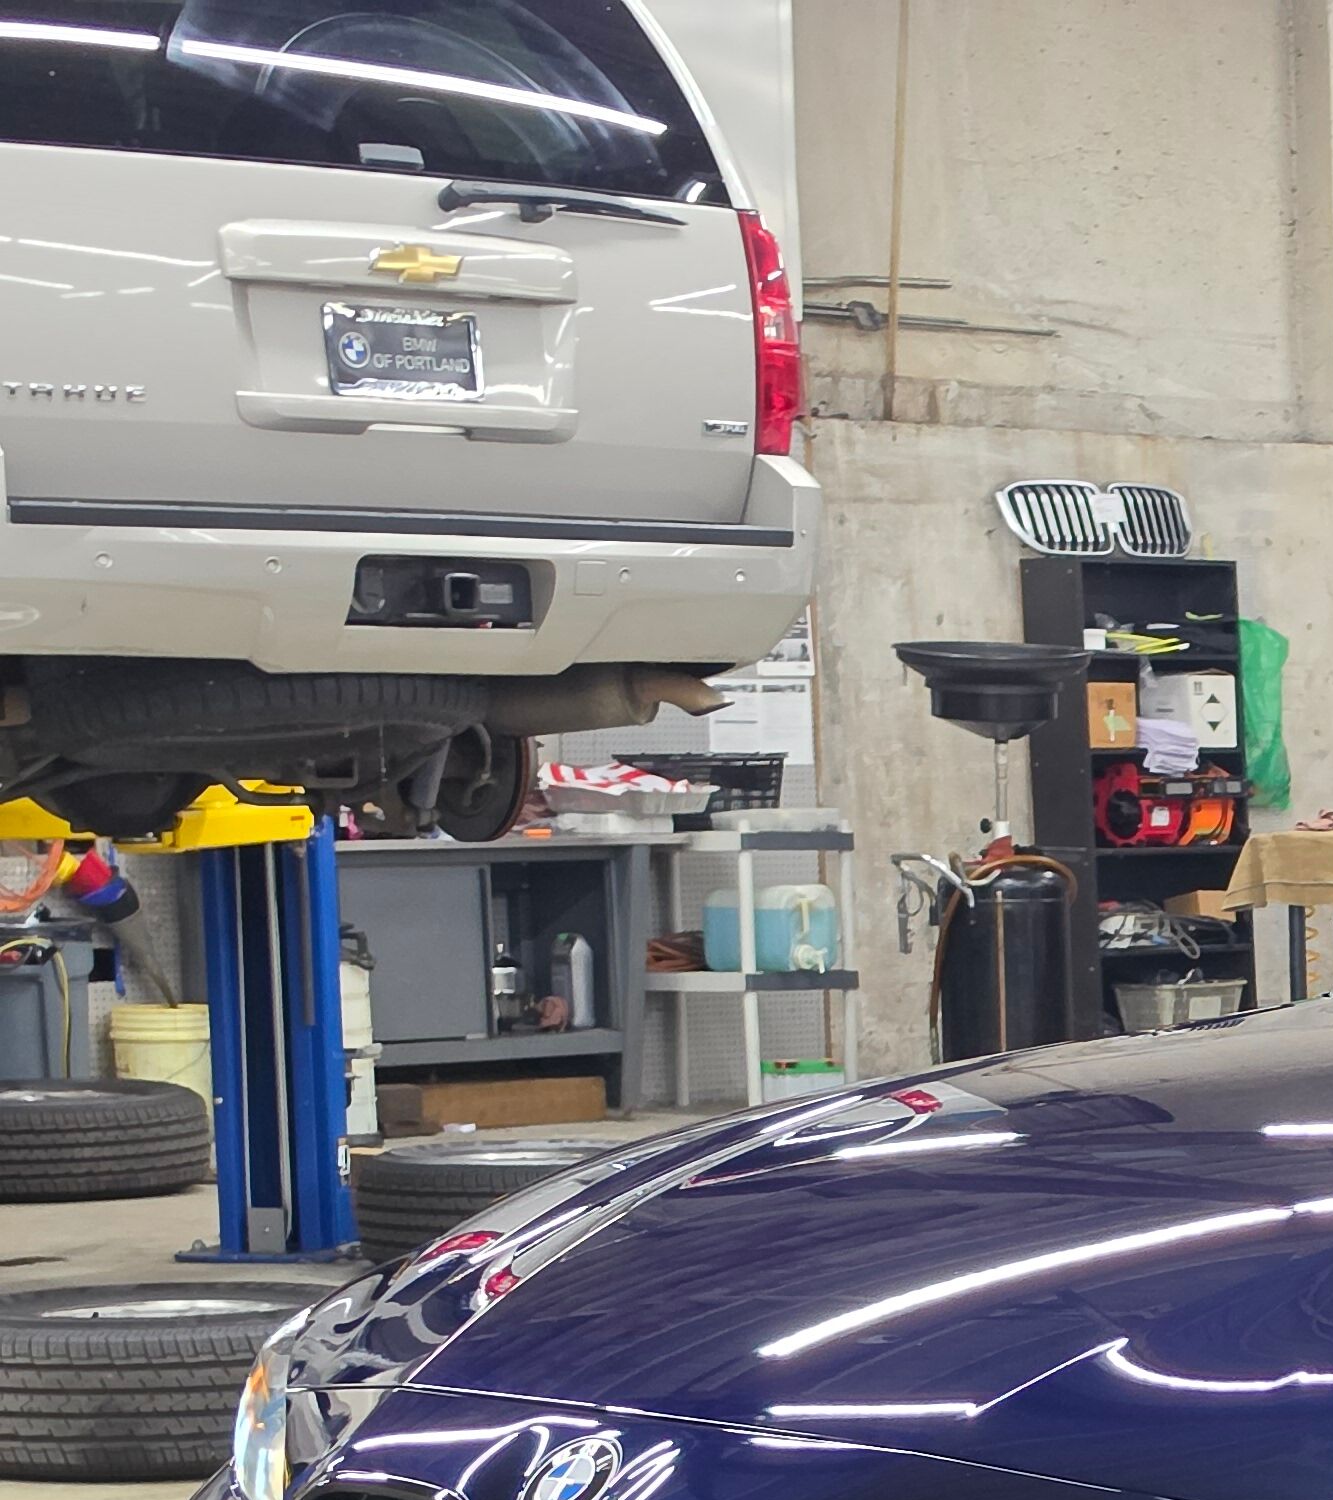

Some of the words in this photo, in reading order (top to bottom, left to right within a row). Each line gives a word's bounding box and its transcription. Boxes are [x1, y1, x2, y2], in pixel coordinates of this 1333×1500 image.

[402, 336, 438, 352] BMW
[372, 353, 393, 369] OF
[395, 355, 471, 374] PORTLAND
